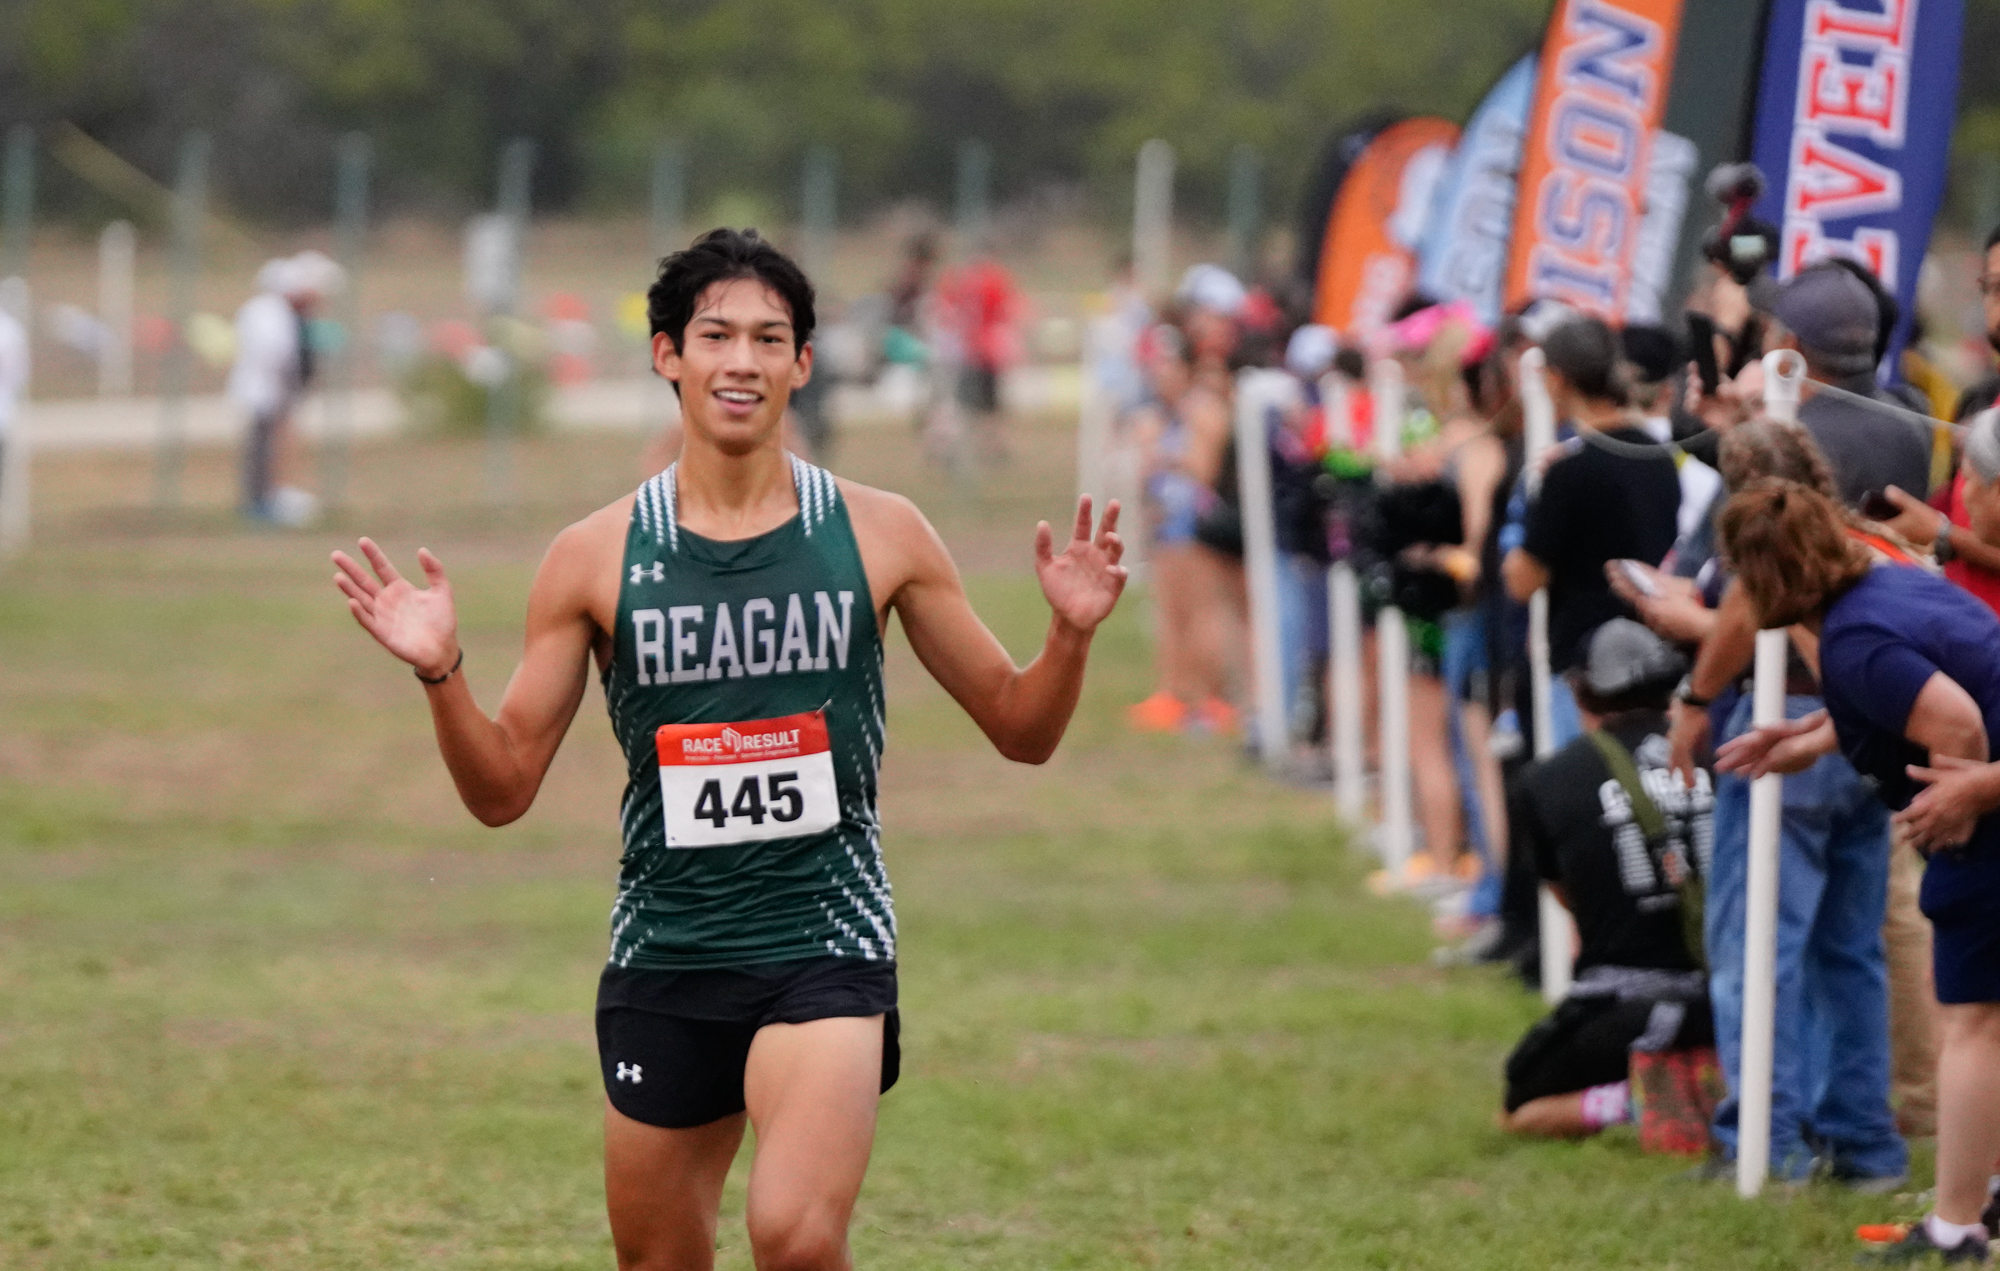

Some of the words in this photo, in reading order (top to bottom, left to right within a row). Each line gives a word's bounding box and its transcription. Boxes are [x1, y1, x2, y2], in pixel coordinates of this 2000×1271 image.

[632, 590, 854, 685] REAGAN
[682, 737, 723, 753] RACE
[742, 729, 800, 749] RESULT
[693, 771, 804, 829] 445
